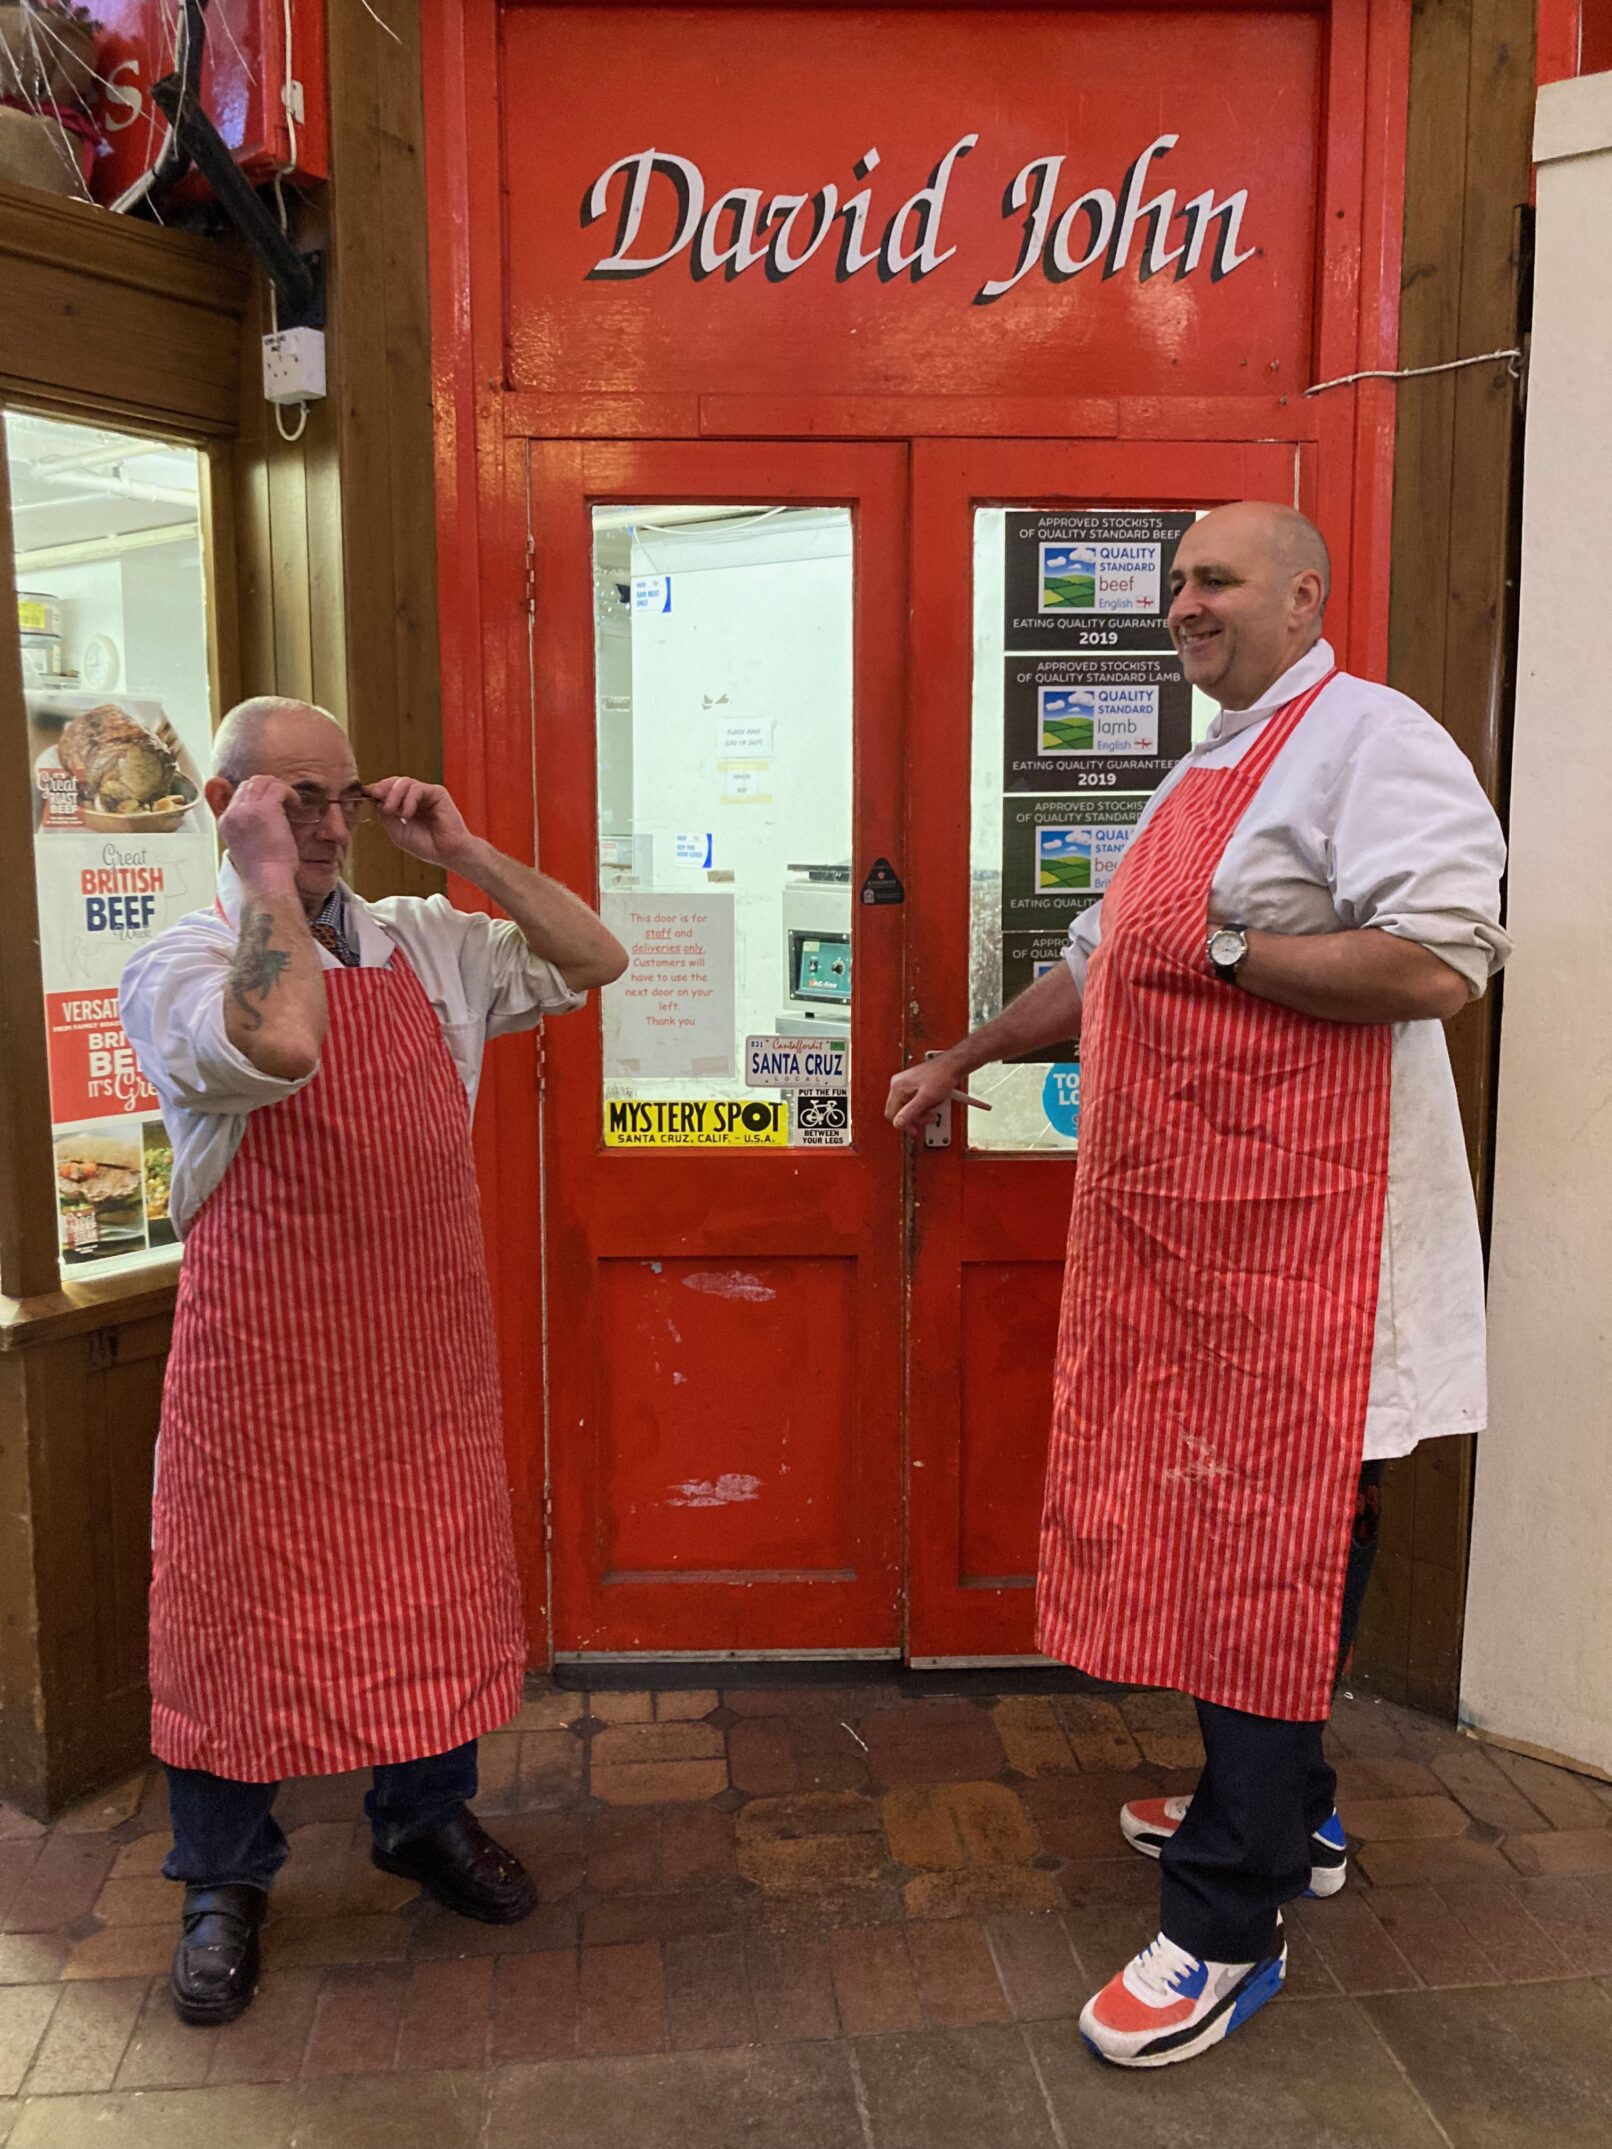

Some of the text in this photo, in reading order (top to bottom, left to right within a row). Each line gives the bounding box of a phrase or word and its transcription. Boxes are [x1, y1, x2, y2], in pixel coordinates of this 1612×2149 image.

[580, 133, 1256, 306] David John
[1038, 517, 1163, 528] APPROVED STOCKISTS
[1019, 529, 1181, 540] OF QUALITY STANDARD BEEF
[1100, 547, 1156, 559] QUALITY
[1100, 562, 1156, 572] STANDARD
[1100, 576, 1135, 592] beef
[1099, 598, 1133, 611] English
[1013, 618, 1169, 630] EATING QUALITY GUARANTE
[1079, 632, 1118, 645] 2019
[1037, 660, 1160, 672] APPROVED STOCKISTS
[1017, 672, 1181, 684] OF QUALITY STANDARD LAMB
[1098, 690, 1153, 702] QUALITY
[1098, 705, 1153, 714] STANDARD
[1098, 719, 1137, 735] lamb
[1098, 740, 1131, 753] English
[1012, 760, 1053, 771] EATING
[1056, 760, 1104, 771] QUALITY
[1078, 772, 1117, 786] 2019
[1035, 801, 1095, 812] APPROVED
[1016, 813, 1032, 823] OF
[1034, 813, 1082, 823] QUALITY
[1095, 830, 1130, 841] QUAL
[1095, 844, 1125, 853] STAN
[103, 843, 148, 872] Great
[81, 867, 164, 895] BRITISH
[1010, 898, 1051, 909] EATING
[86, 895, 155, 931] BEEF
[630, 912, 708, 923] This door is for
[645, 927, 693, 939] staff and
[632, 943, 681, 954] deliveries
[1012, 949, 1028, 959] OF
[633, 957, 705, 968] Customers will
[631, 972, 708, 982] have to use the
[625, 987, 714, 999] next door on your
[62, 998, 119, 1022] VERSAT
[645, 1016, 696, 1028] Thank you
[88, 1031, 125, 1050] BRI
[89, 1048, 134, 1077] BE
[752, 1053, 843, 1075] SANTA CRUZ
[114, 1069, 159, 1112] Gre
[799, 1088, 847, 1096] PUT THE FUN
[610, 1102, 783, 1133] MYSTERY SPOT
[618, 1134, 656, 1143] SANTA
[744, 1134, 775, 1143] U.S.A.
